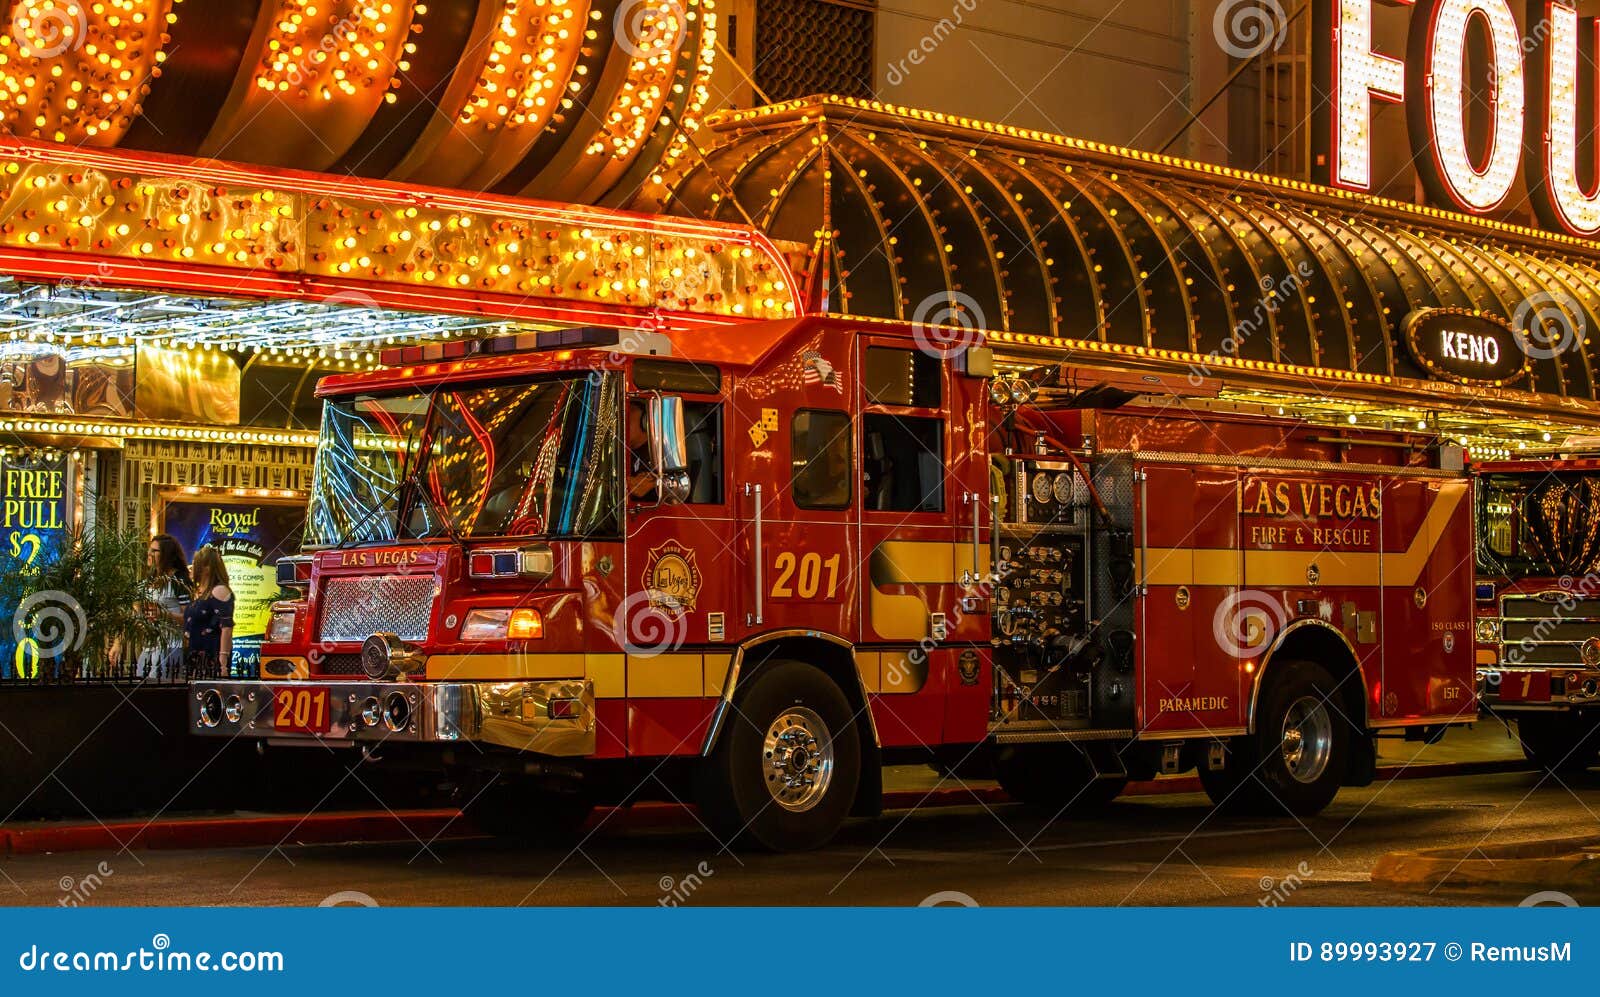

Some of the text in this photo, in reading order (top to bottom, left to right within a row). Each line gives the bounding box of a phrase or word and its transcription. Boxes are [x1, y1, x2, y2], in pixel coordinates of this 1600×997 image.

[1332, 0, 1600, 236] FOU
[1441, 330, 1499, 365] KENO
[5, 470, 63, 498] FREE
[1237, 480, 1381, 519] LAS VEGAS
[4, 500, 63, 529] PULL
[209, 507, 260, 537] Royal
[1251, 526, 1371, 545] FIRE & RESCUE
[342, 550, 418, 566] LAS VEGAS
[771, 551, 841, 599] 201
[1431, 621, 1444, 631] ISO
[1445, 621, 1465, 631] CLASS
[1443, 687, 1460, 700] 1517
[1521, 674, 1532, 698] 1
[276, 690, 325, 728] 201
[1159, 696, 1230, 712] PARAMEDIC
